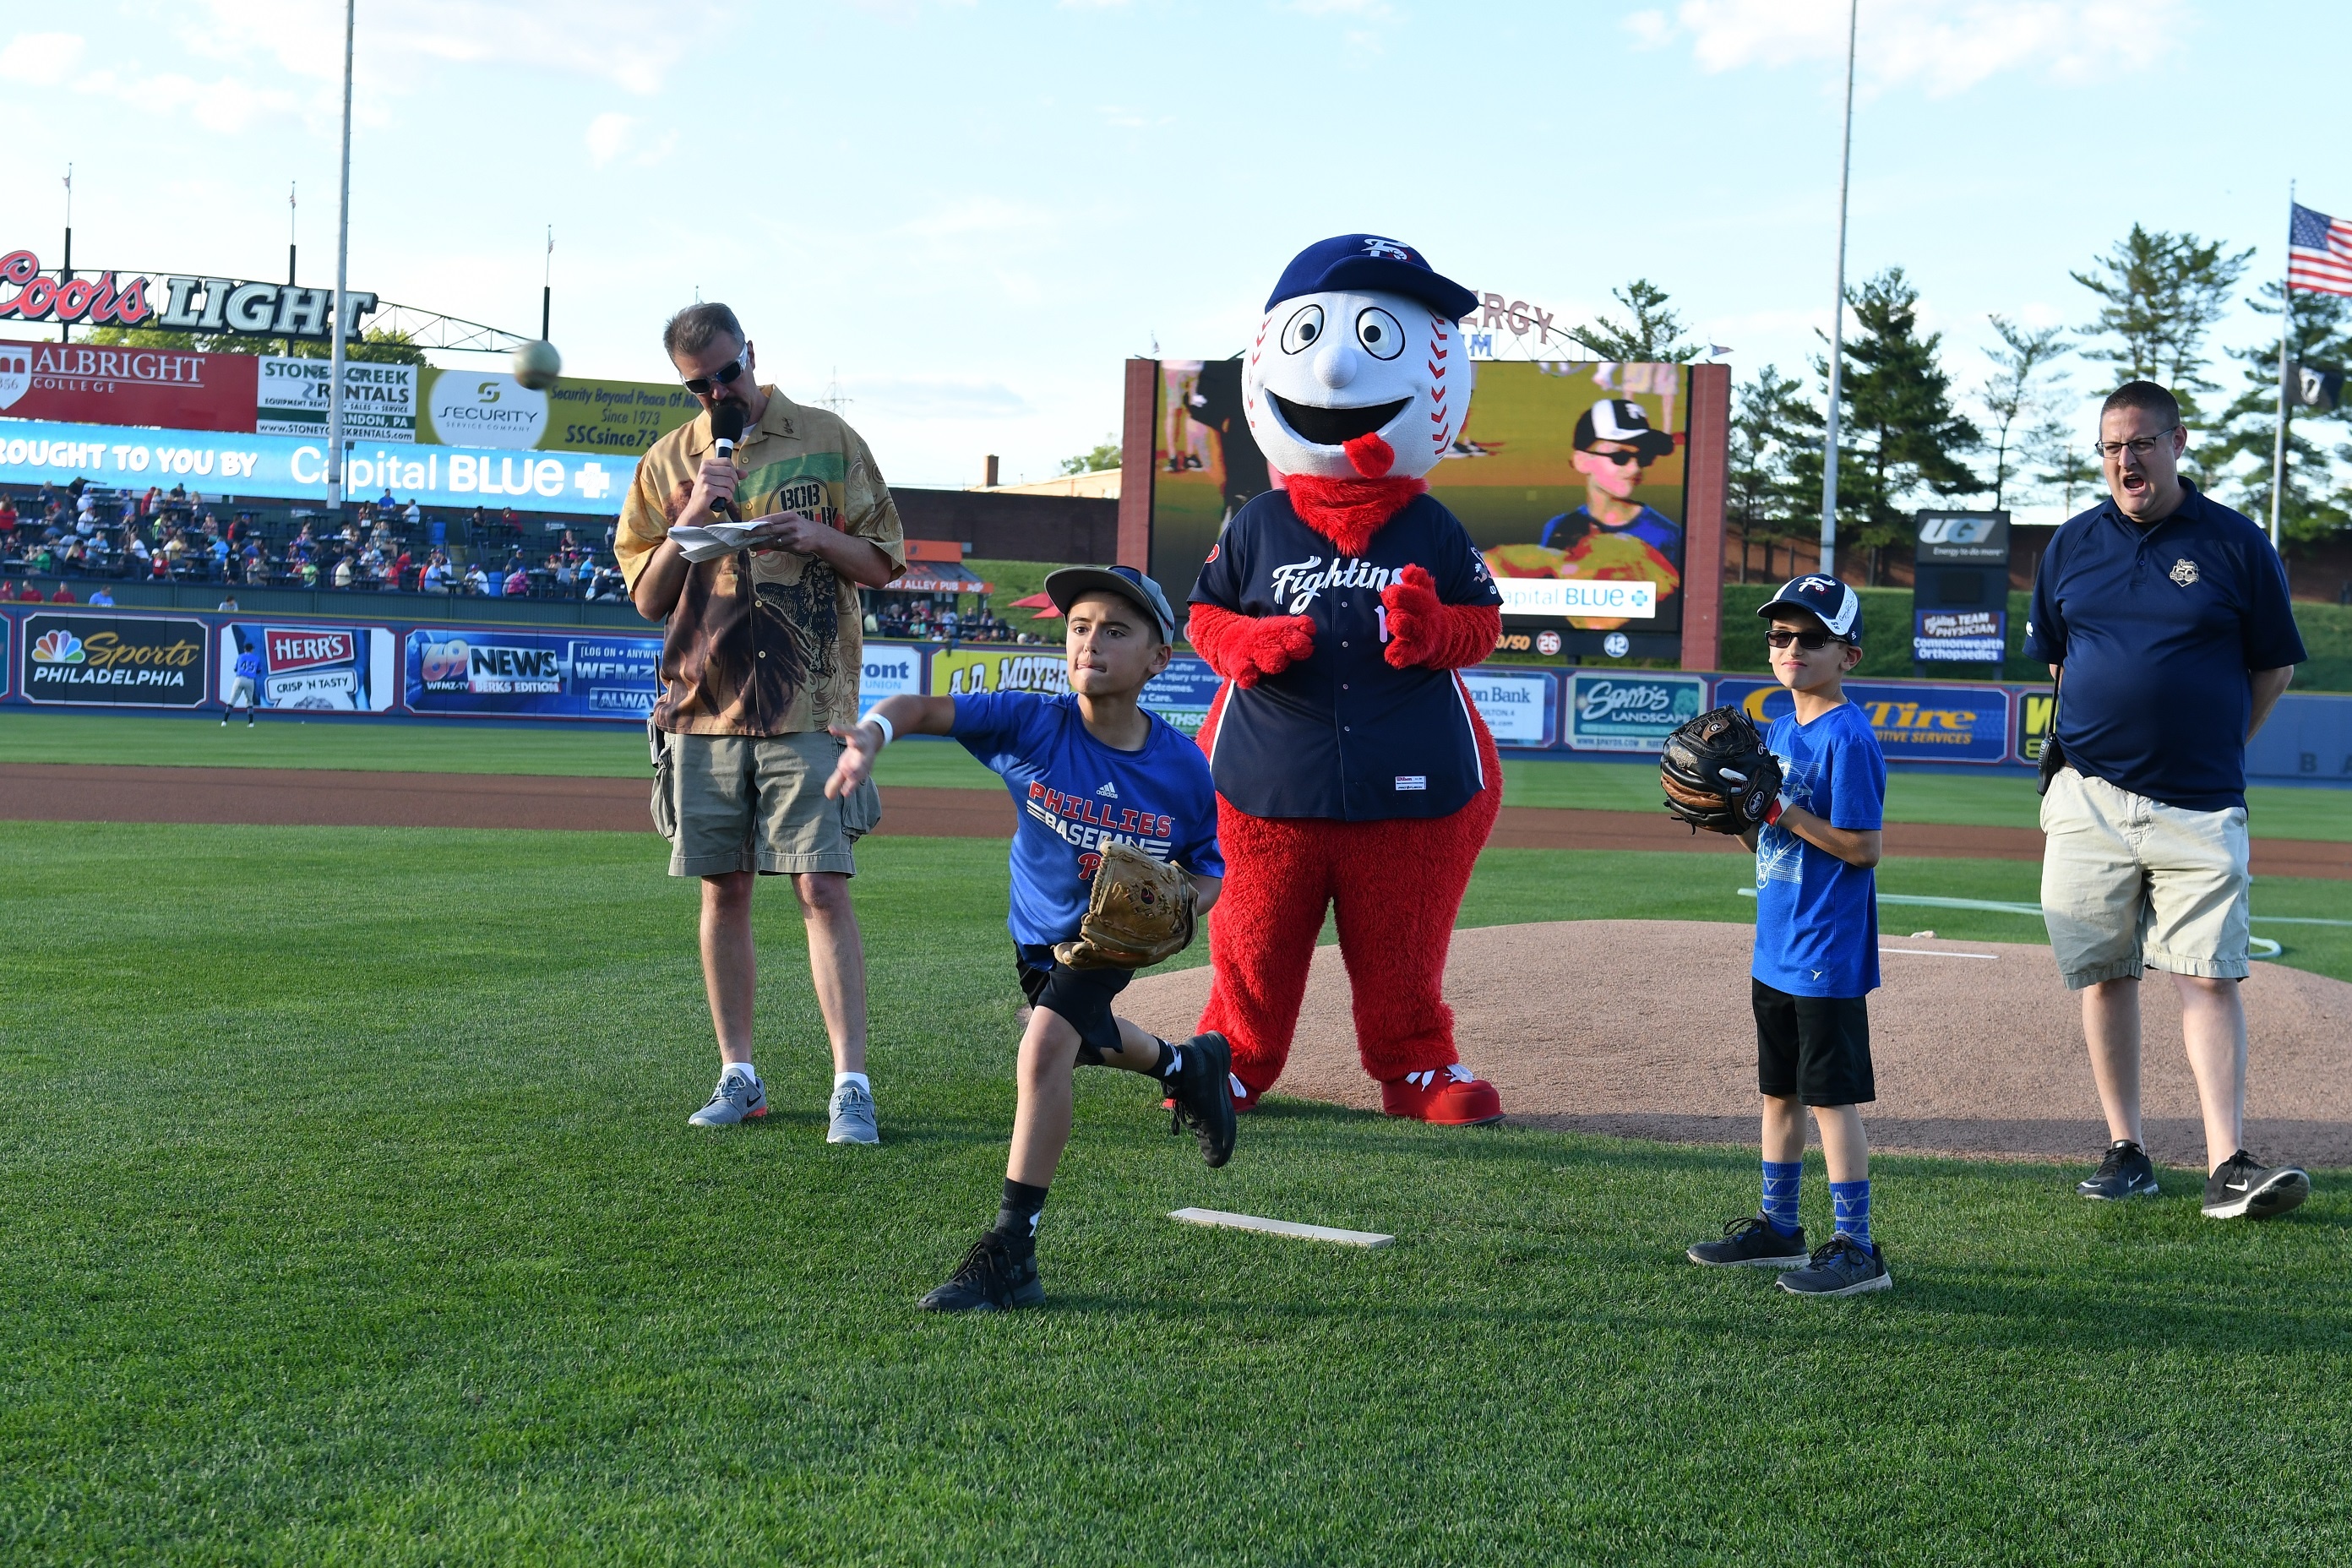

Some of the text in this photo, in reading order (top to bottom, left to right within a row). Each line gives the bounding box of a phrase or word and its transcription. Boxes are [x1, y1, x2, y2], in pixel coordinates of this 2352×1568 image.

[0, 249, 378, 339] Coors LIGHT
[32, 346, 206, 383] ALBRIGHT
[264, 362, 409, 385] STONE CREEK
[33, 377, 116, 393] COLLEGE
[317, 383, 409, 403] RNTALS
[551, 385, 592, 406] Security
[595, 388, 634, 407] Beyond
[636, 390, 667, 407] Peace
[669, 392, 683, 408] Of
[264, 398, 307, 407] EQUIPMENT
[350, 403, 371, 411] SALES
[381, 405, 408, 413] SERVICE
[393, 416, 408, 427] PA
[438, 406, 538, 423] SECURITY
[602, 407, 661, 426] Since 1973
[446, 422, 531, 433] SERVICE COMPANY
[564, 424, 659, 448] SSCsince73
[112, 444, 150, 471] TO
[155, 446, 215, 475] YOU
[220, 451, 259, 477] BY
[780, 483, 820, 511] BOB
[1919, 518, 1996, 544] UGI
[1933, 547, 1959, 558] Energy
[1969, 548, 1980, 557] do
[904, 580, 938, 591] ALLEY
[939, 581, 959, 591] PUB
[1499, 587, 1559, 607] apital
[1957, 612, 1990, 626] TEAM
[1936, 623, 1996, 638] PHYSICIAN
[84, 631, 200, 672] Sports
[274, 634, 345, 662] HERR'S
[1538, 637, 1558, 651] 26
[1606, 639, 1626, 654] 42
[1913, 637, 2005, 651] Commonwealth
[422, 639, 559, 682] 69 NEWS
[603, 647, 617, 657] ON
[626, 648, 664, 659] ANYWHE
[1918, 649, 1999, 662] Orthopaedics
[862, 661, 910, 679] ont
[998, 656, 1070, 694] MOYER
[1174, 663, 1195, 672] after
[33, 666, 185, 687] PHILADELPHIA
[865, 679, 902, 689] UNION
[1201, 675, 1224, 683] surg
[276, 681, 302, 694] CRISP
[318, 677, 348, 689] TASTY
[426, 681, 560, 694] WFMZ-TV BERKS EDITION
[1143, 683, 1195, 693] Outcomes.
[1147, 693, 1173, 703] Care.
[1491, 686, 1531, 704] Bank
[1864, 700, 1977, 730] Tire
[1911, 732, 1973, 744] SERVICES
[1096, 788, 1119, 799] adidas
[1028, 780, 1172, 838] PHILLIES
